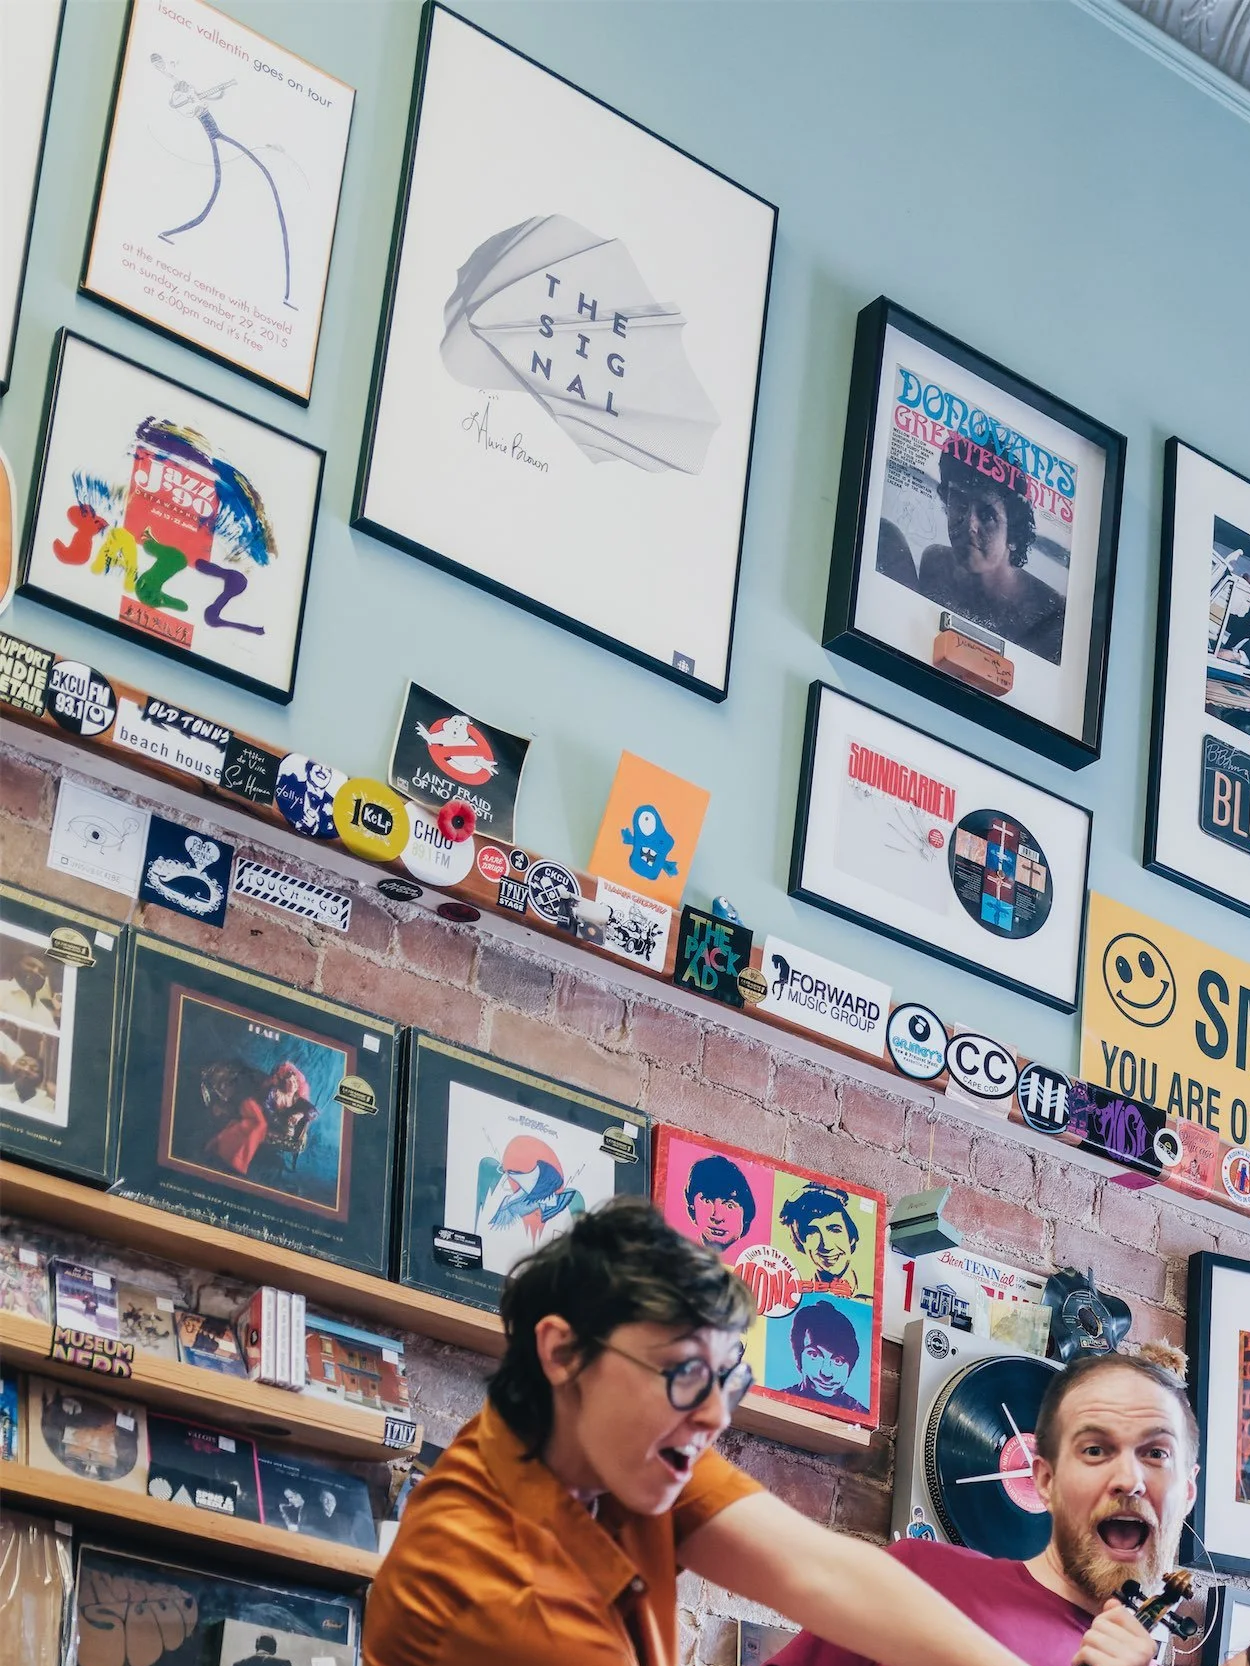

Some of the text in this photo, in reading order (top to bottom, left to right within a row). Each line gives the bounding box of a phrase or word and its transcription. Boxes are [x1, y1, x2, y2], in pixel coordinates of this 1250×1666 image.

[196, 24, 251, 63] vallentin
[253, 57, 284, 83] goes
[287, 76, 304, 93] on
[307, 86, 333, 109] tour
[122, 242, 293, 336] at the record centre with bosveld
[122, 257, 136, 271] on
[183, 289, 236, 322] november
[259, 327, 289, 349] 2015
[143, 284, 156, 295] at
[157, 290, 200, 320] 6:00pm
[203, 315, 224, 332] and
[243, 334, 264, 352] free
[894, 404, 1026, 492] GREATEST
[896, 367, 1075, 499] DONOVAN'S
[53, 503, 266, 636] JAZZ
[0, 635, 52, 671] UPPORT
[0, 653, 48, 691] NDIE
[0, 673, 44, 709] ETAIL
[50, 668, 110, 705] CKCU FM
[55, 692, 83, 720] 93.1
[148, 700, 232, 745] OLD TOWNS
[120, 726, 222, 780] beach house
[412, 776, 428, 790] OF
[430, 786, 450, 799] NO
[458, 786, 491, 812] FRAID
[848, 741, 957, 825] SOUNDGARDEN
[192, 837, 213, 854] PARK
[434, 850, 451, 869] FM
[544, 867, 570, 887] CKCU
[318, 901, 340, 916] GO
[498, 898, 525, 913] STAGE
[689, 912, 735, 957] THE
[682, 954, 719, 991] AD
[684, 934, 742, 978] PACK
[787, 990, 876, 1034] MUSIC GROUP
[788, 967, 881, 1023] FORWARD
[955, 1040, 1009, 1086] CC
[962, 1074, 1000, 1094] CAPE COD
[1101, 1039, 1158, 1107] YOU
[1166, 1071, 1222, 1134] ARE
[762, 1246, 771, 1257] To
[771, 1248, 782, 1260] The
[781, 1255, 797, 1273] Band
[762, 1259, 777, 1270] THE
[902, 1259, 916, 1313] 1
[55, 1326, 134, 1361] MUSEUM
